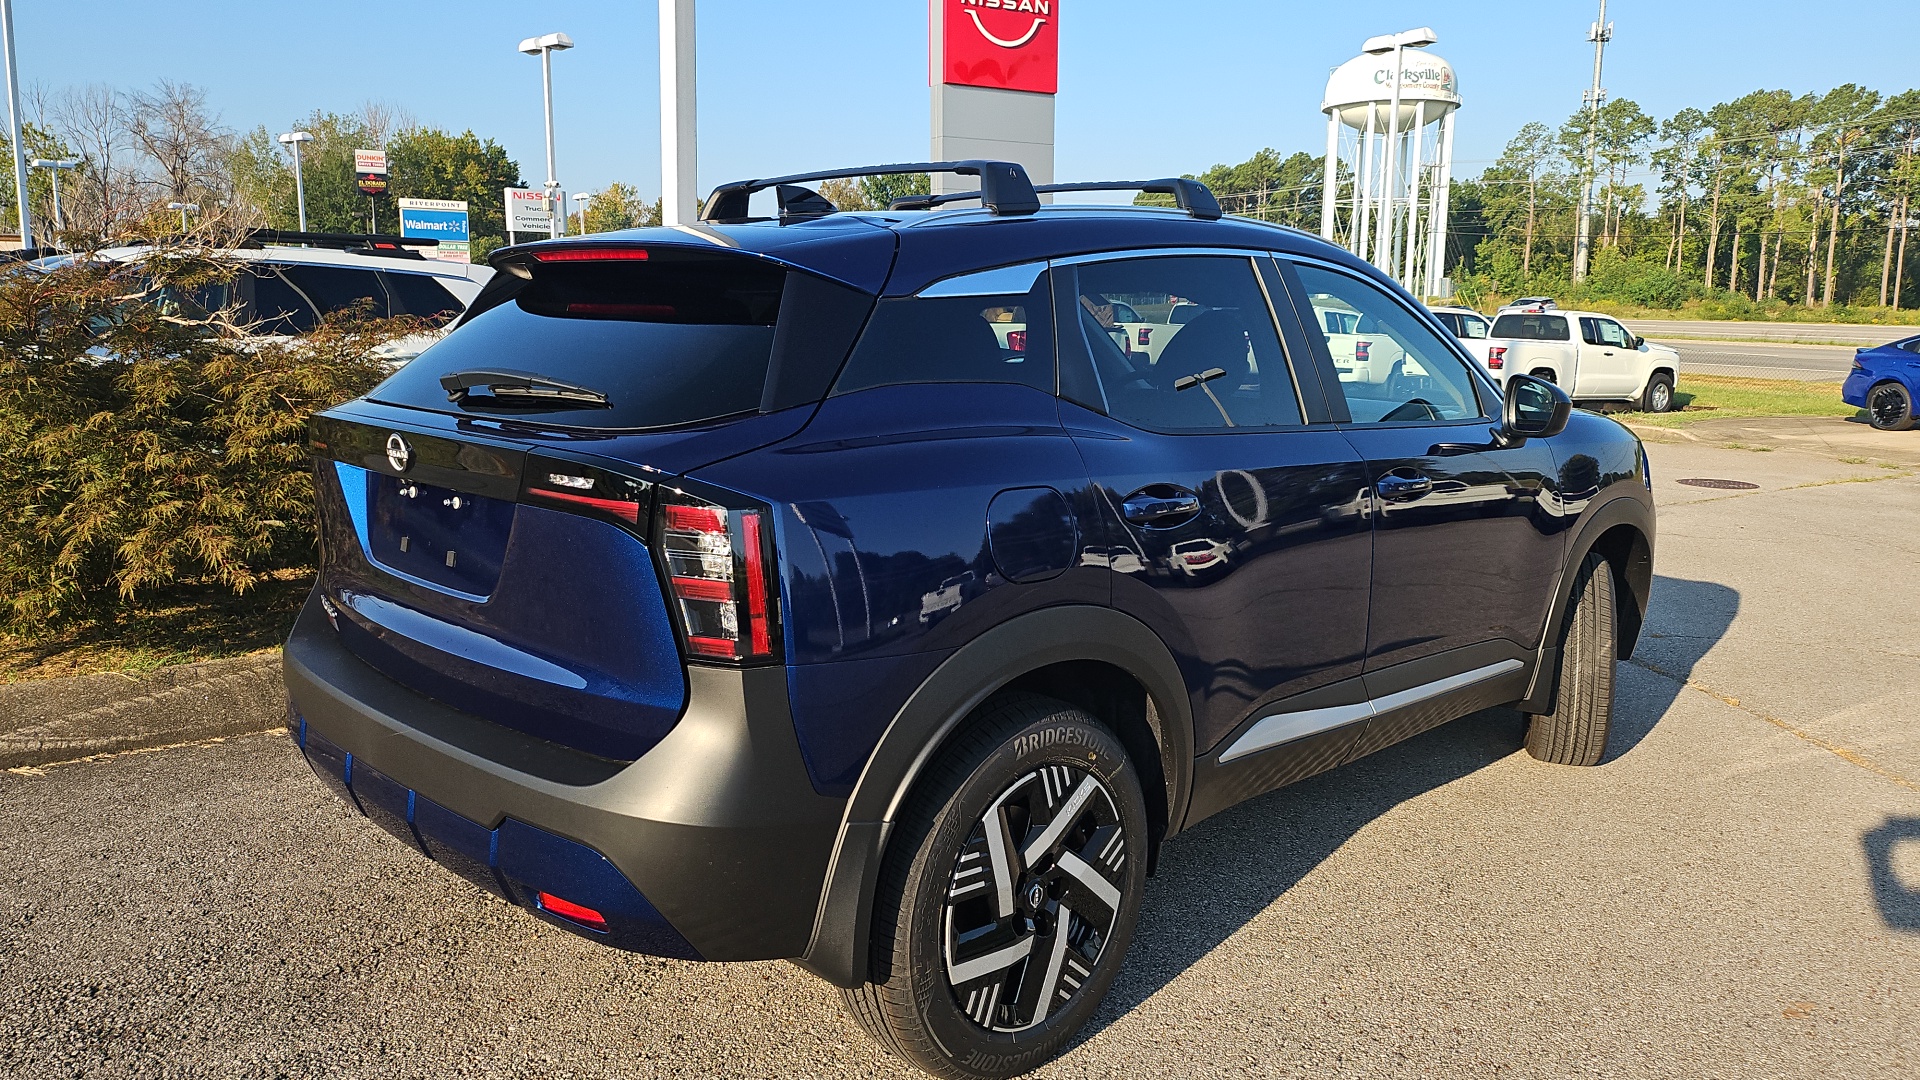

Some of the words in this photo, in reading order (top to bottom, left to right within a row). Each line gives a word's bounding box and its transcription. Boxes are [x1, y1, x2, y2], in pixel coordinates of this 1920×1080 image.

[961, 0, 1049, 14] SSAN
[513, 191, 560, 201] NISS
[409, 200, 461, 208] RIVERPOINT
[404, 219, 448, 231] Walmart
[387, 447, 409, 459] SSAN
